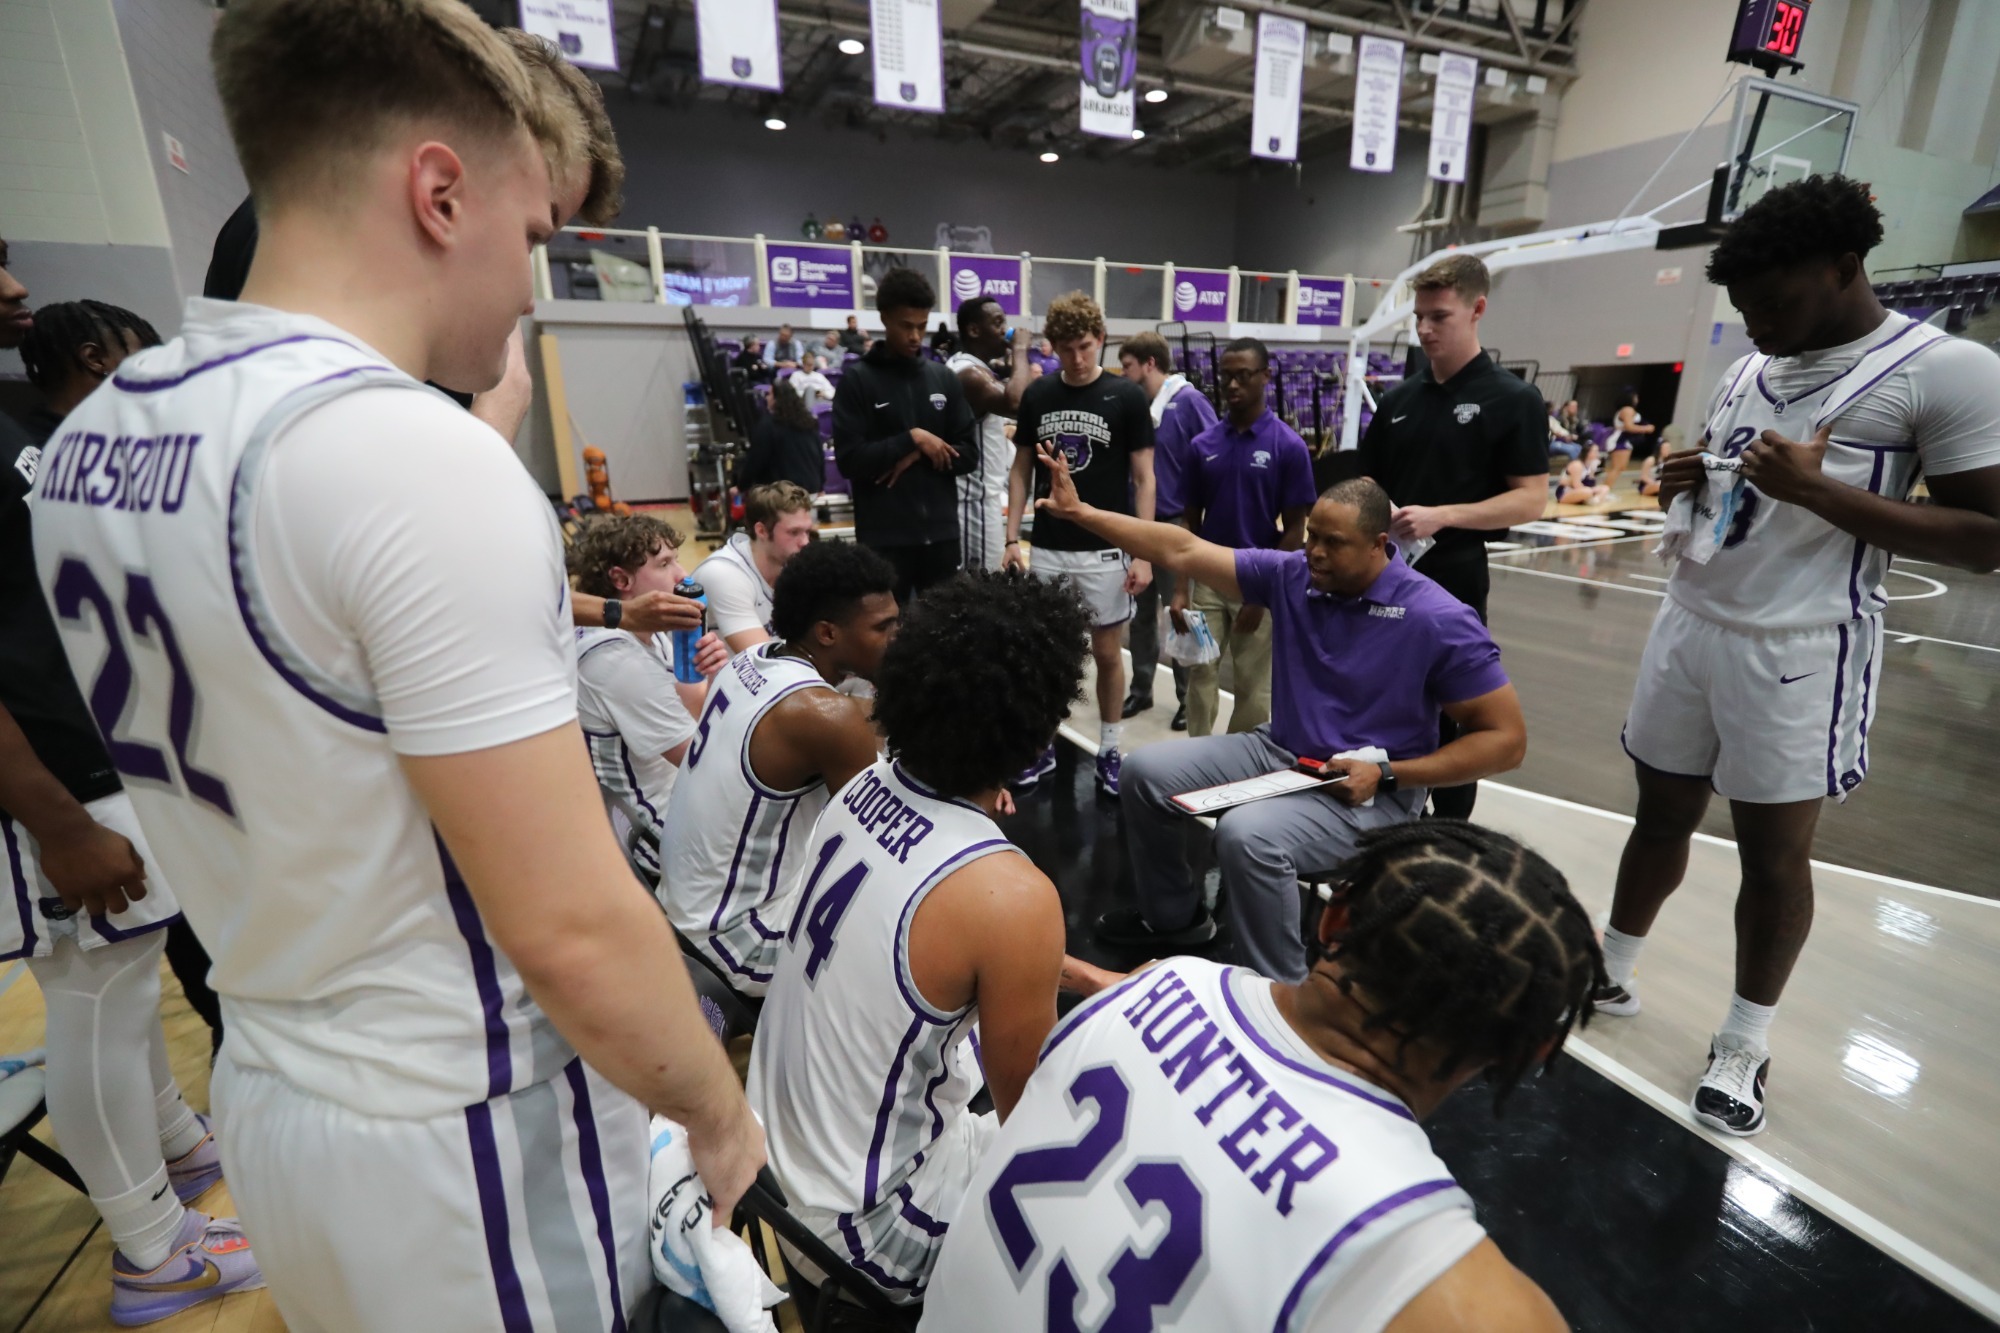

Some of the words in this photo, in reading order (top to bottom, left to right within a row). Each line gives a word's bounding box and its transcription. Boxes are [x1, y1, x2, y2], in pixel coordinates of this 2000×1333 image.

[1766, 2, 1804, 55] 30
[1083, 101, 1132, 117] ARKANSAS
[799, 260, 847, 274] Simmons
[983, 279, 1018, 296] AT&T
[1199, 290, 1227, 306] AT&T
[1037, 420, 1112, 442] ARKANSAS
[1041, 410, 1109, 430] CENTRAL
[53, 554, 246, 832] 22
[687, 687, 730, 772] 5
[843, 769, 934, 865] COOPER
[786, 831, 873, 991] 14
[1122, 970, 1339, 1218] HUNTER
[983, 1061, 1209, 1333] 23
